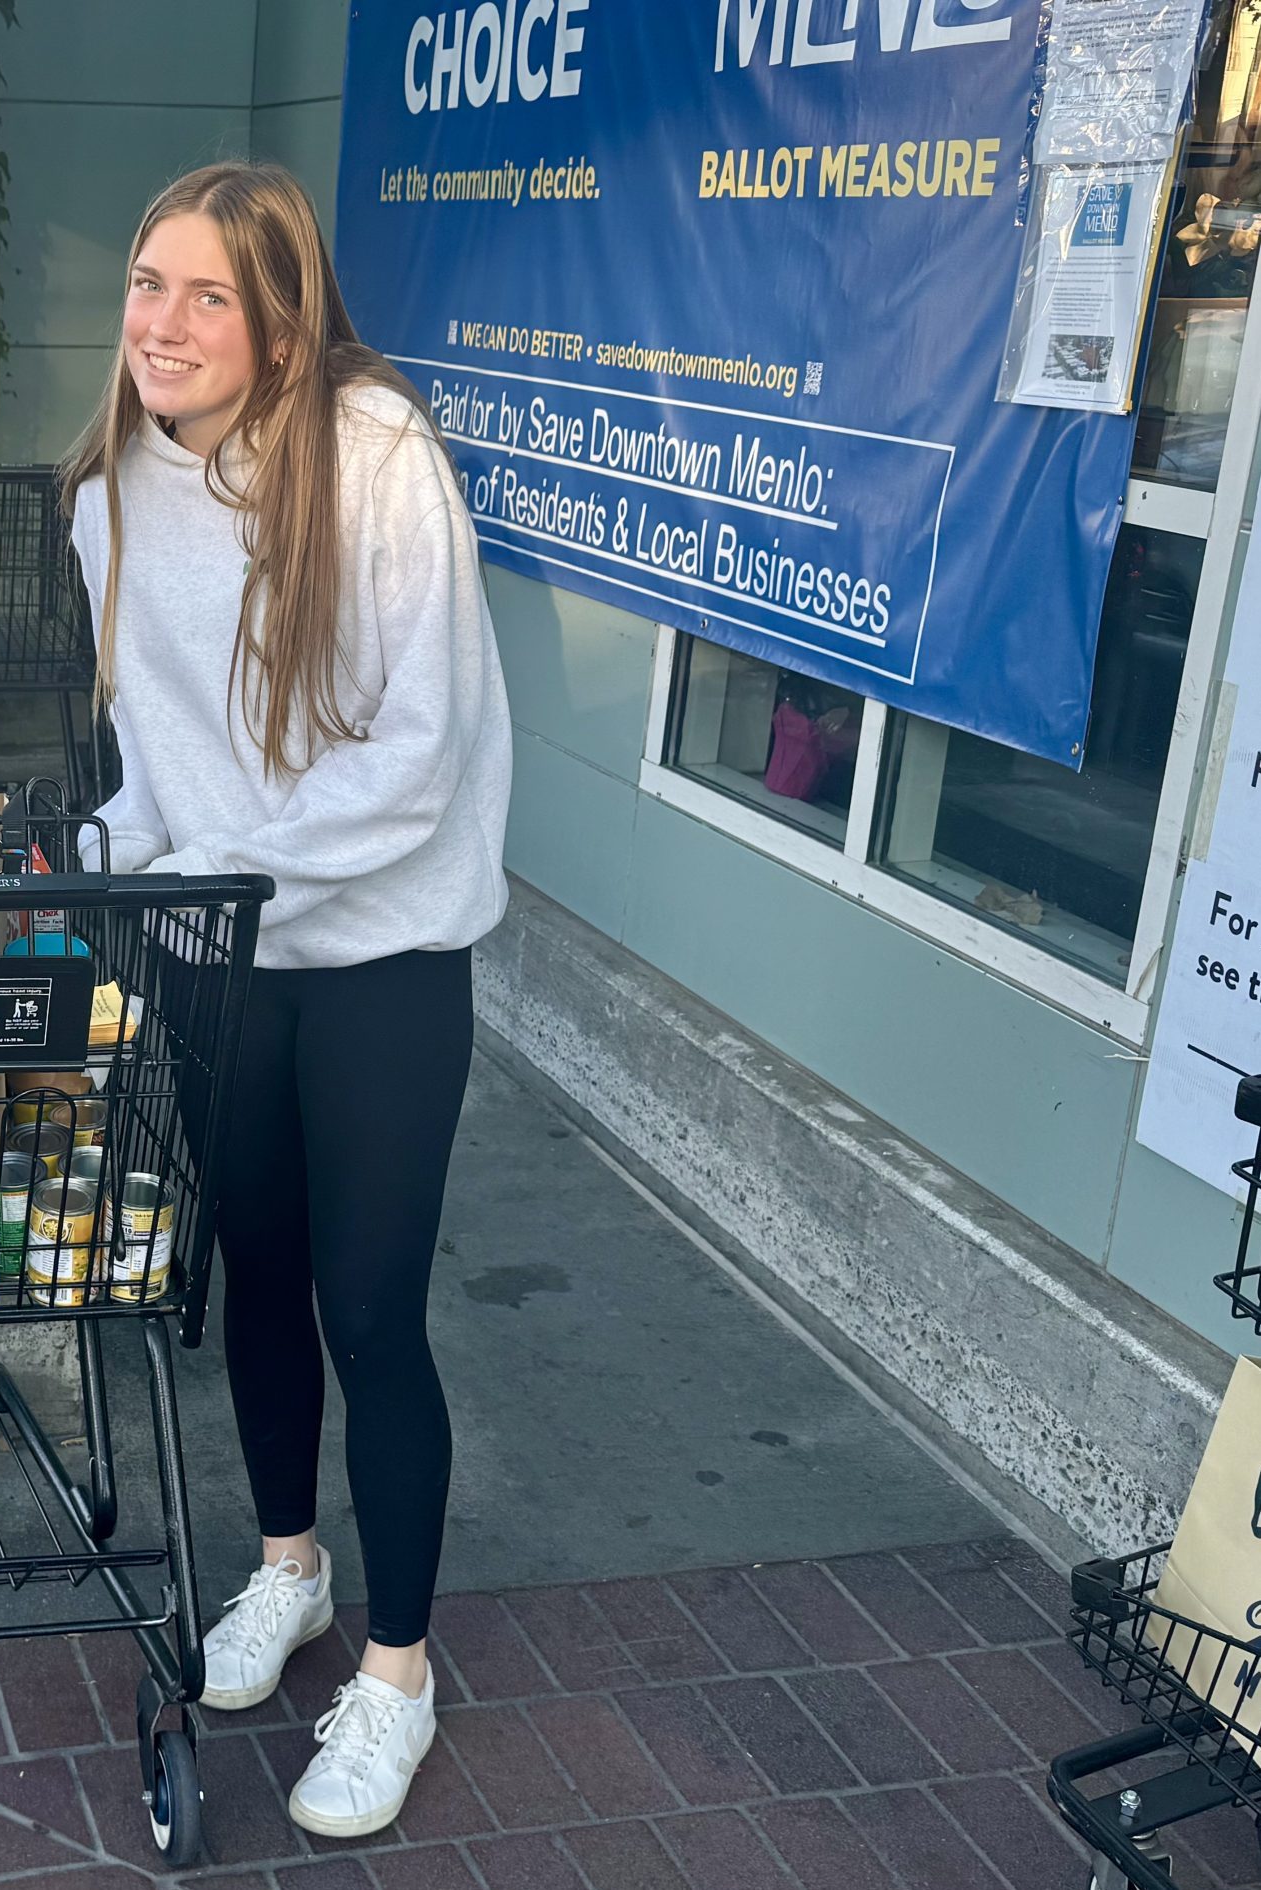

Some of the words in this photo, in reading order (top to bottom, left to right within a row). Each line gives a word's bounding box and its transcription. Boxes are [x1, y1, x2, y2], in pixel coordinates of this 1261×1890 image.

[404, 0, 589, 115] CHOICE
[380, 167, 403, 202] Let
[406, 165, 428, 201] the
[432, 160, 526, 207] community
[529, 156, 600, 199] decide.
[698, 146, 813, 199] BALLOT
[818, 138, 1000, 198] MEASURE
[1089, 186, 1114, 201] SAVE
[462, 321, 483, 348] WE
[483, 325, 507, 351] CAN
[508, 327, 529, 354] DO
[530, 329, 583, 362] BETTER
[595, 340, 799, 398] savedowntownmenlo.org
[431, 379, 470, 433] Paid
[468, 385, 495, 438] for
[498, 391, 525, 458] by
[527, 396, 585, 460] Save
[589, 407, 722, 491] Downtown
[727, 433, 834, 516] Menlo:
[474, 464, 501, 514] of
[502, 468, 607, 547] Residents
[612, 496, 630, 555] &
[636, 502, 709, 578] Local
[713, 522, 892, 635] Businesses
[1210, 890, 1259, 941] For
[1196, 954, 1240, 991] see
[1248, 972, 1261, 1002] t
